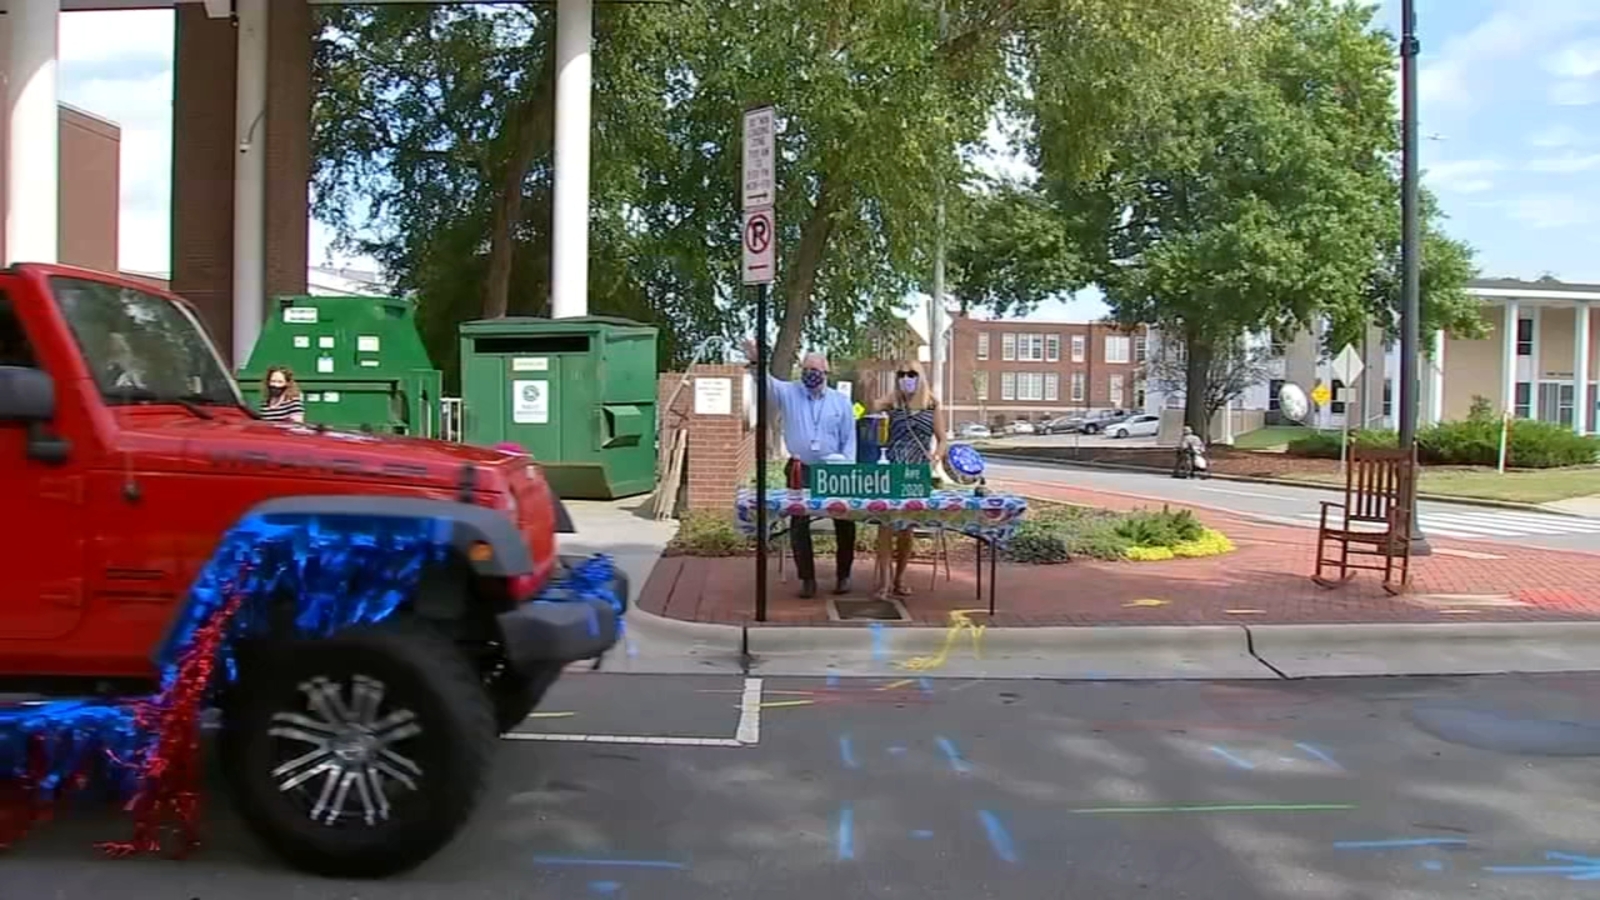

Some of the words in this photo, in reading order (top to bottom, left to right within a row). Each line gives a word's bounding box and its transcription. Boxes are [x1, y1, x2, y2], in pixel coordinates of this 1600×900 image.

[816, 468, 891, 495] Bonfield
[904, 467, 921, 480] Ave
[900, 483, 925, 497] 2020
